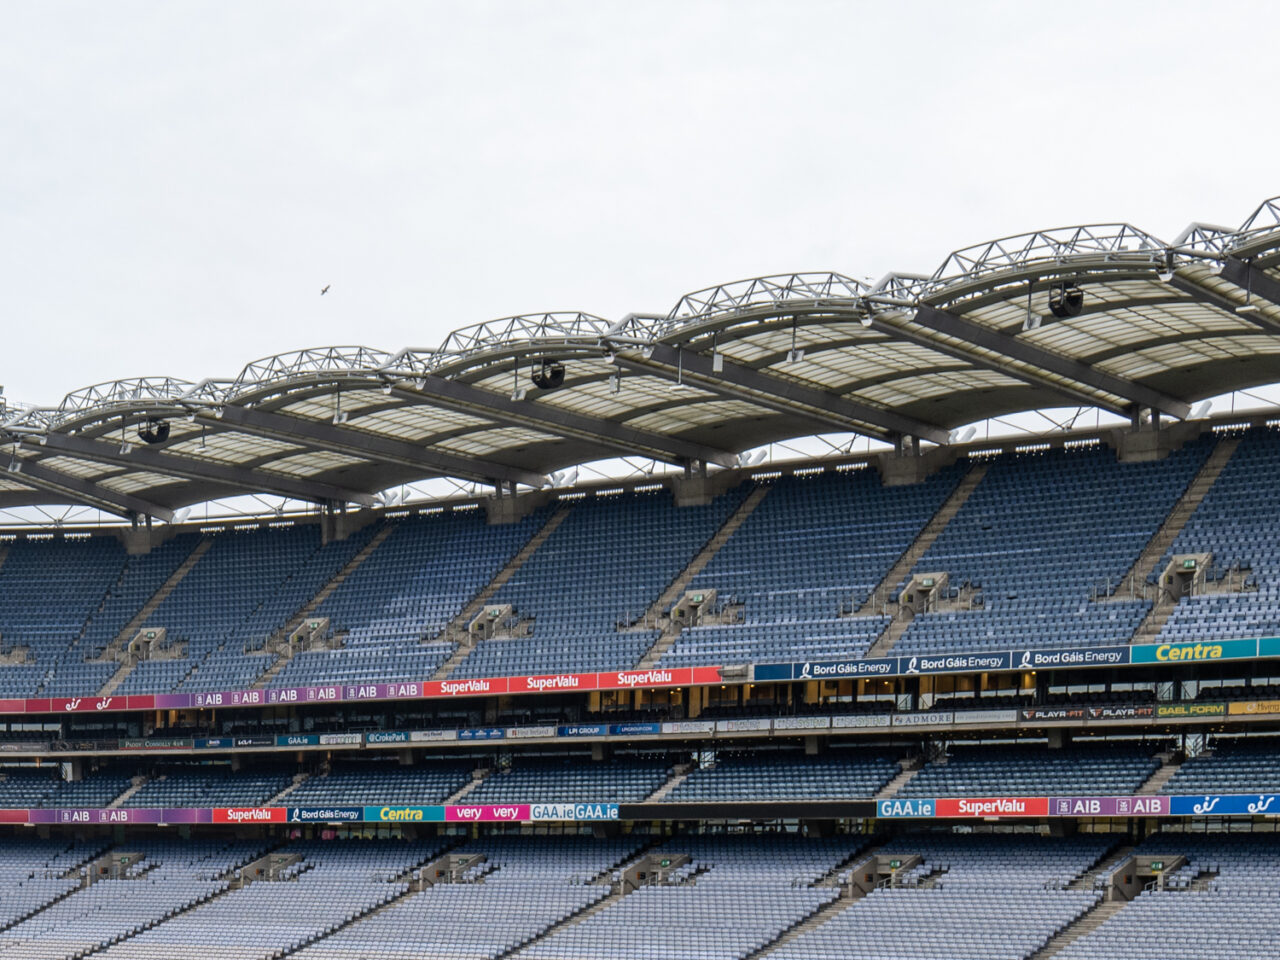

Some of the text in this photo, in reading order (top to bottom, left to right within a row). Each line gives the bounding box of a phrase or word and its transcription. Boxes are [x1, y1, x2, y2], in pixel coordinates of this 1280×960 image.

[1034, 650, 1122, 664] Bord Gáis Energy
[1156, 643, 1222, 661] Centra
[813, 662, 891, 675] Bord Gáis Energy
[921, 656, 1004, 670] Bord Gáis Energy
[527, 677, 579, 690] SuperValu
[617, 671, 672, 686] SuperValu
[317, 687, 336, 699] AIB
[358, 686, 377, 698] AIB
[398, 684, 418, 696] AIB
[441, 681, 490, 695] SuperValu
[205, 694, 223, 705] AIB
[241, 691, 260, 703] AIB
[279, 690, 298, 701] AIB
[65, 697, 81, 711] eir
[96, 696, 112, 710] eir
[1158, 705, 1224, 714] GAEL FORM
[905, 714, 951, 723] ADMORE
[288, 737, 308, 745] GAA.ie
[368, 733, 406, 742] @CrokePark
[881, 801, 932, 816] GAA.ie
[958, 798, 1025, 815] SuperValu
[1073, 800, 1101, 813] AIB
[1133, 800, 1162, 813] AIB
[1193, 796, 1220, 814] eir
[1248, 795, 1275, 813] eir
[72, 811, 90, 821] AIB
[109, 811, 128, 821] AIB
[227, 809, 271, 821] SuperValu
[301, 809, 359, 820] Bord Gáis Energy
[380, 808, 423, 821] Centra
[456, 808, 482, 820] very
[493, 807, 519, 819] very
[533, 805, 574, 819] GAA.ie
[576, 805, 618, 818] GAA.ie
